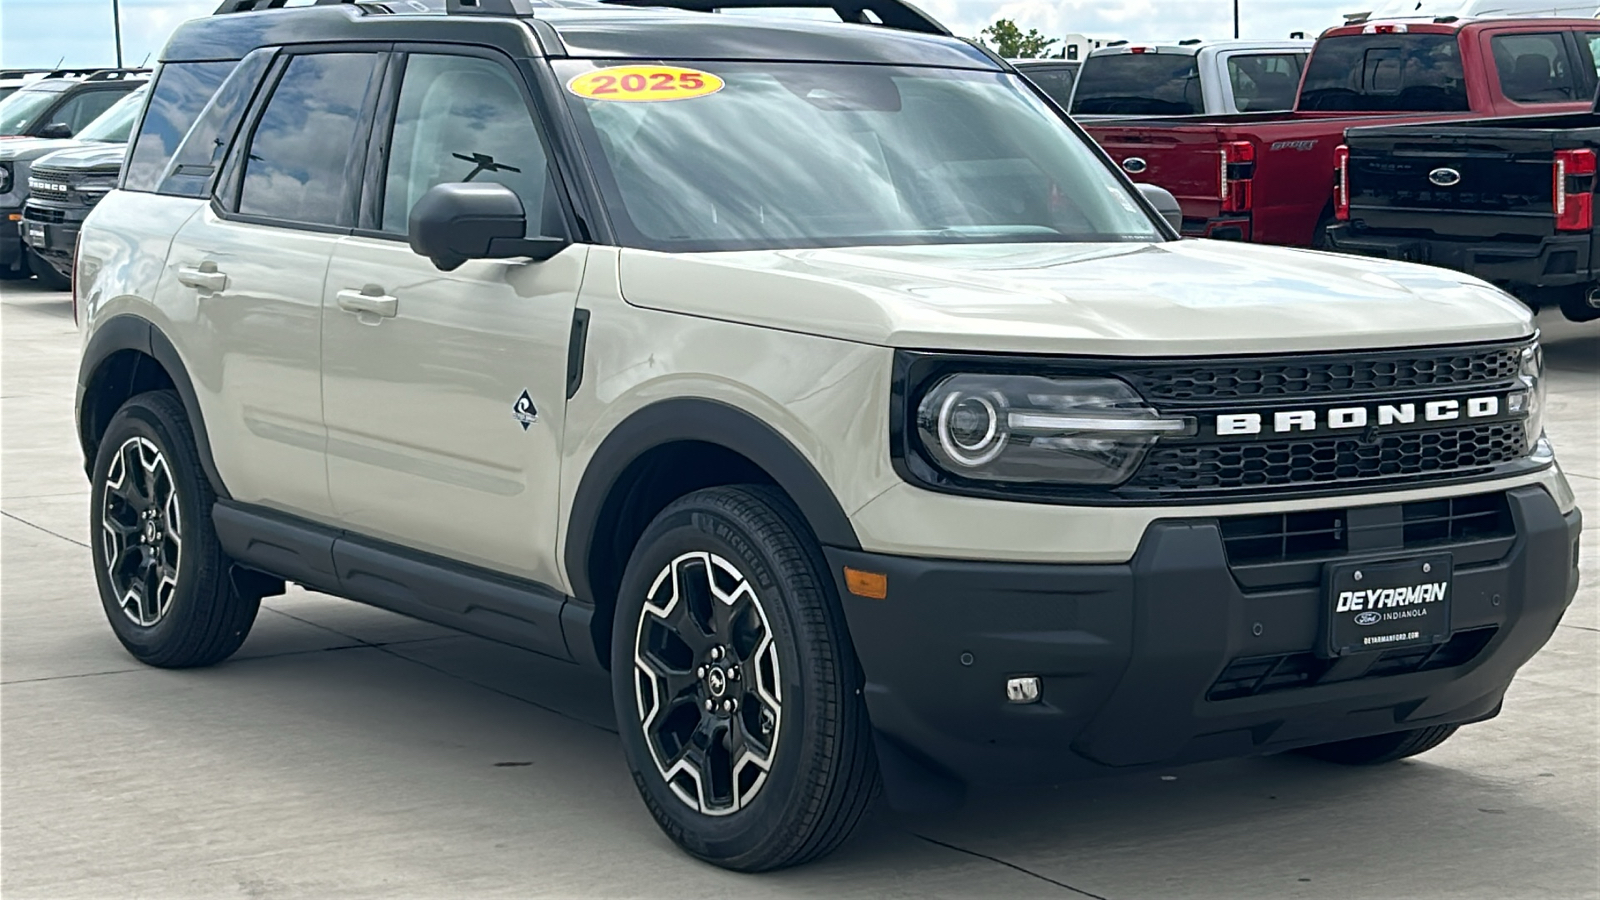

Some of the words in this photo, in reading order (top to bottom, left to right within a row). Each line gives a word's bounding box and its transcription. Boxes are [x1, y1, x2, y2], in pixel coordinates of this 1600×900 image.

[591, 73, 704, 94] 2025
[1216, 396, 1498, 435] BRONCO
[716, 523, 771, 587] MICHELIN
[1336, 582, 1447, 612] DEYARMAN
[1383, 608, 1427, 620] INDIANOLA
[1363, 631, 1420, 645] DEYARMANFORD.COM
